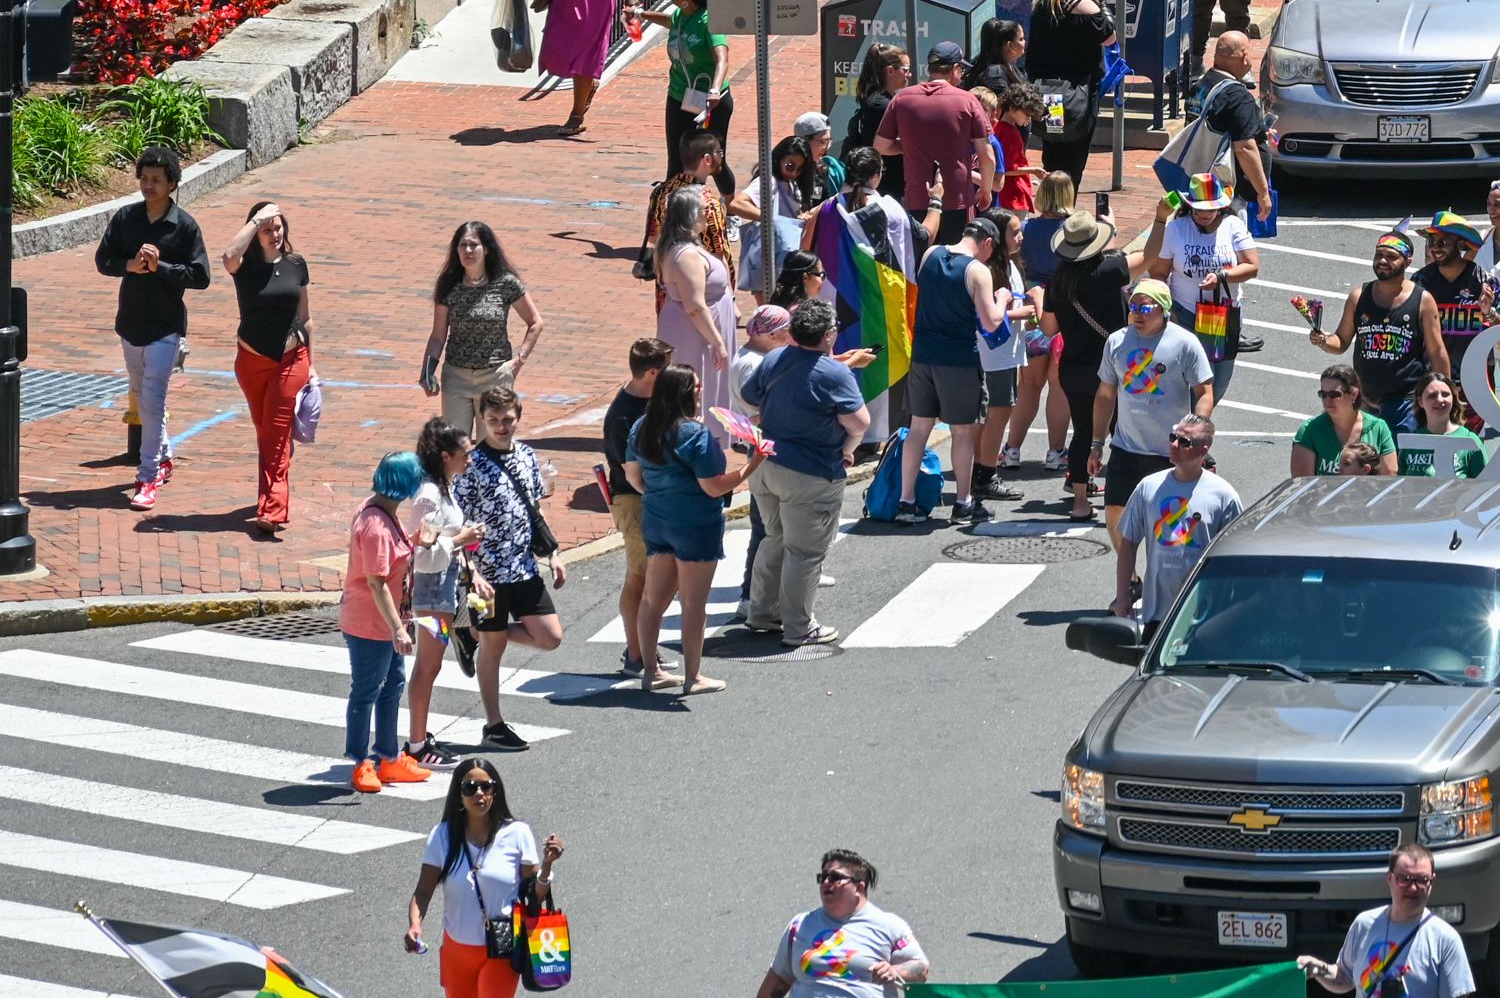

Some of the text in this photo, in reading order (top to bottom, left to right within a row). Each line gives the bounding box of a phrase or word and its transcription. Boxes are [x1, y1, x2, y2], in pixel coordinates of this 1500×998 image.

[860, 19, 929, 38] TRASH
[1380, 123, 1427, 137] 3ZD 772
[1402, 326, 1414, 339] Out
[1406, 453, 1433, 465] M&T
[1222, 921, 1283, 939] 2EL 862
[539, 928, 566, 963] &
